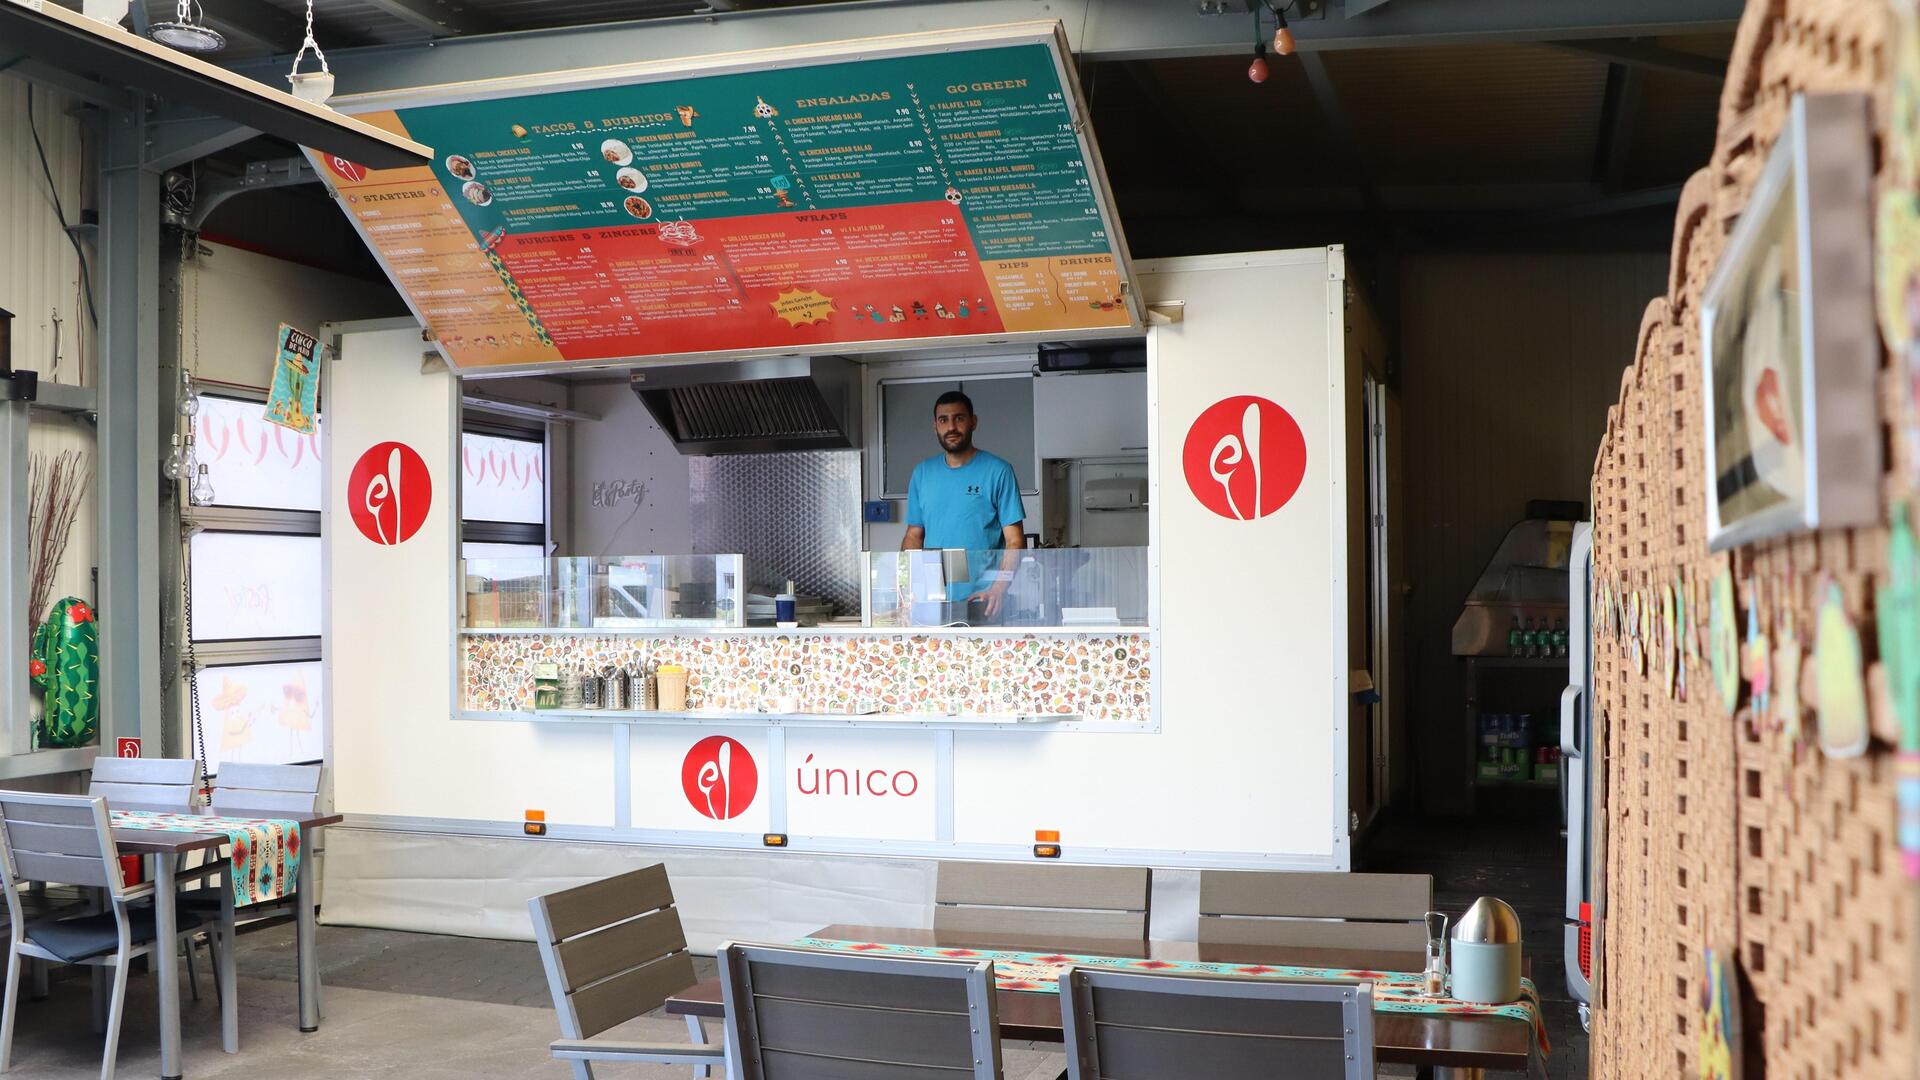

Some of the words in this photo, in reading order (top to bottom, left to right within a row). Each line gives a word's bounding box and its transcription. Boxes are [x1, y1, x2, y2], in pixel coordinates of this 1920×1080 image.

[945, 84, 969, 94] GO
[970, 78, 1028, 91] GREEN
[795, 91, 891, 107] ENSALADAS
[937, 101, 964, 110] FALAFEL
[965, 99, 982, 107] TACO
[530, 122, 577, 133] TACOS
[583, 120, 594, 128] &
[601, 113, 674, 127] BURRITOS
[791, 116, 816, 124] CHICKEN
[815, 114, 843, 122] AVOCADO
[842, 112, 862, 120] SALAD
[673, 131, 696, 139] BURRITO
[948, 131, 976, 140] FALAFEL
[976, 129, 1001, 137] BURRITO
[841, 171, 861, 179] SALAD
[983, 166, 1009, 174] FALAFEL
[1000, 183, 1036, 191] QUESADILLA
[361, 190, 426, 201] STARTERS
[794, 212, 847, 222] WRAPS
[515, 234, 576, 244] BURGERS
[598, 227, 657, 238] ZINGERS
[998, 261, 1029, 269] DIPS
[1059, 255, 1113, 265] DRINKS
[803, 300, 831, 308] Pommes
[290, 333, 312, 349] CINCO
